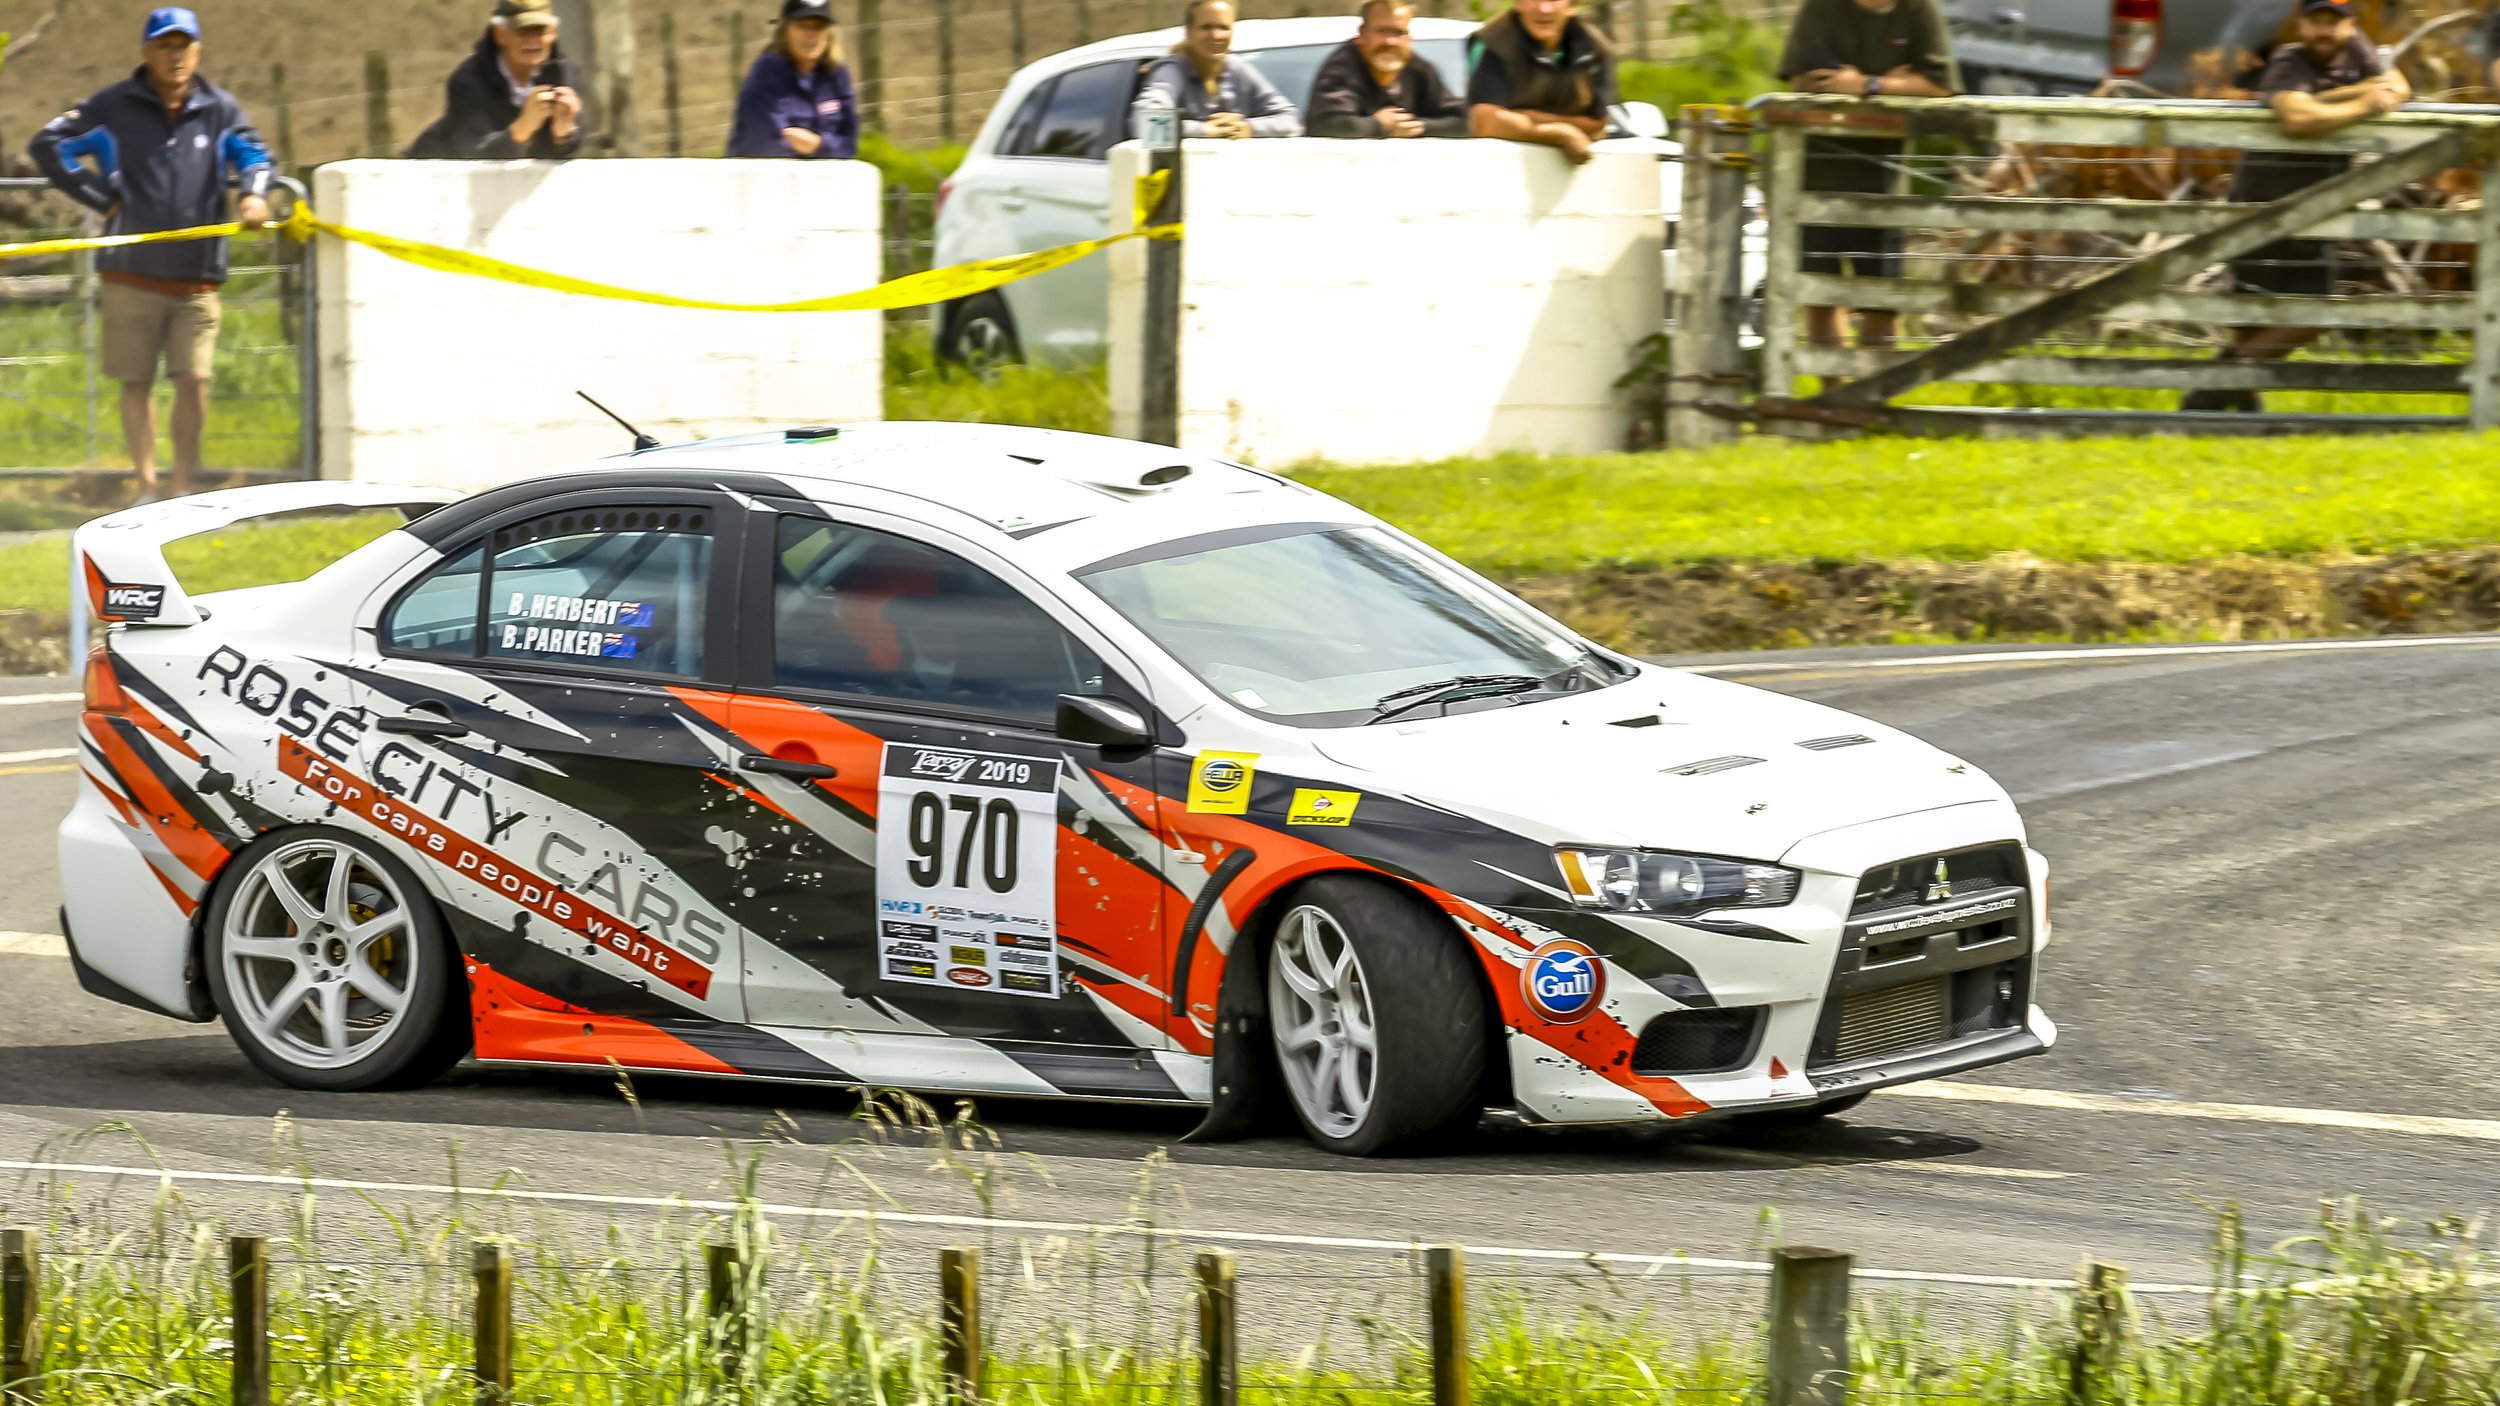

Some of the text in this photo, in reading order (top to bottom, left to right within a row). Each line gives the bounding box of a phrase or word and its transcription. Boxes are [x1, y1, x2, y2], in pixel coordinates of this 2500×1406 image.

[108, 589, 162, 606] WRC
[507, 591, 622, 626] B.HERBERT
[500, 624, 604, 657] B.PARKER
[979, 760, 1031, 784] 2019
[196, 644, 726, 965] ROSE CITY CARS
[906, 790, 1019, 895] 970
[304, 759, 672, 973] For cars people want
[1536, 973, 1592, 998] Gull
